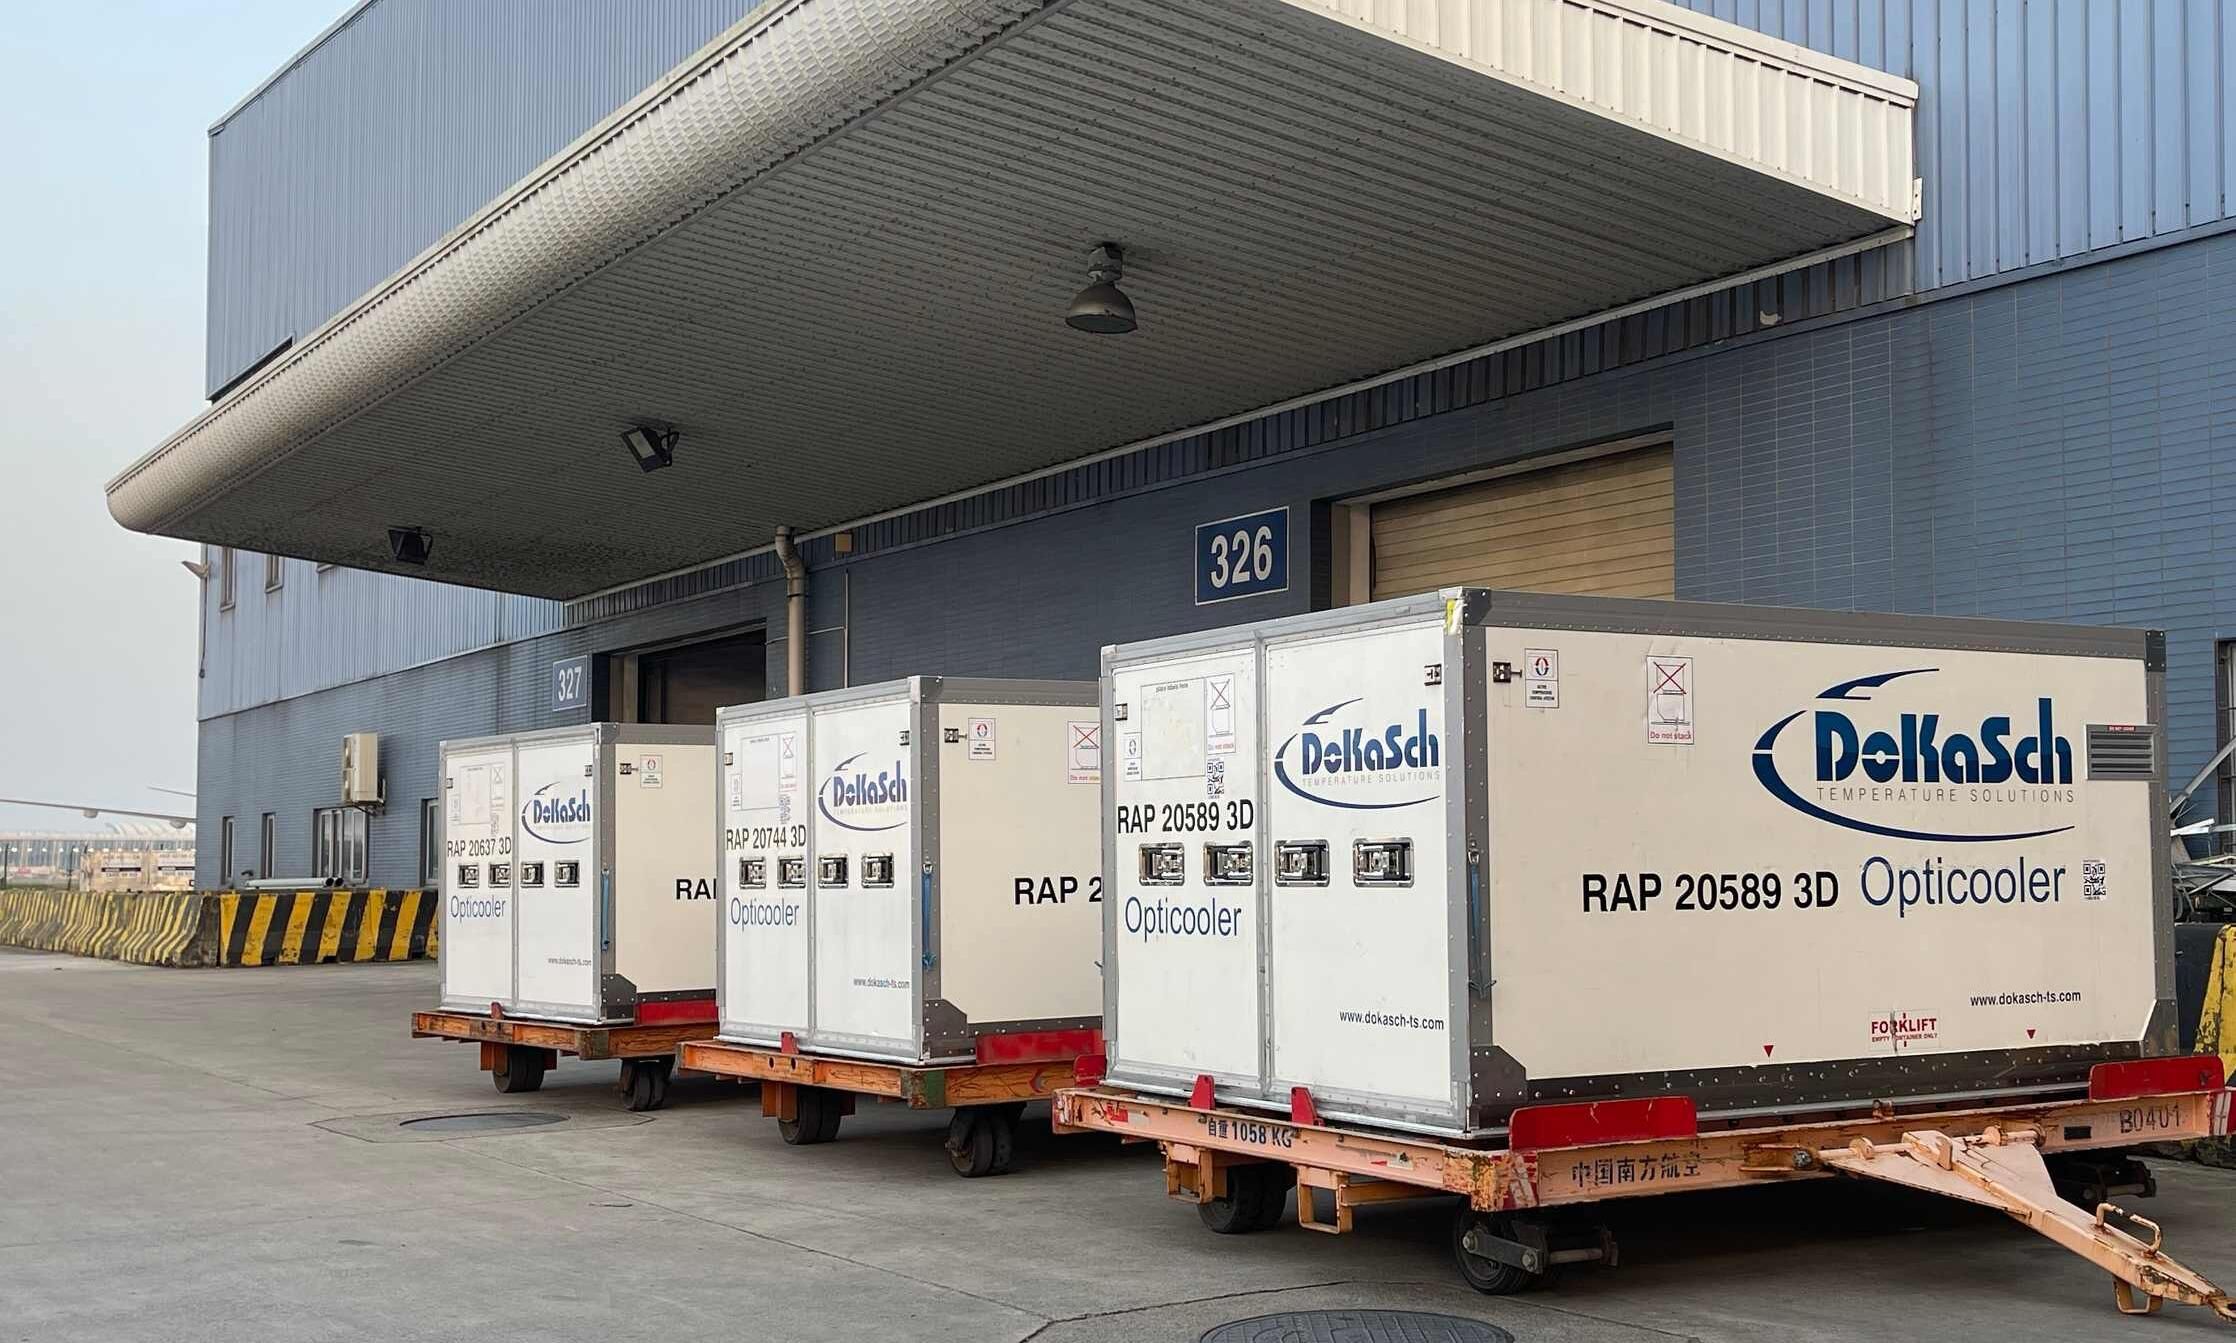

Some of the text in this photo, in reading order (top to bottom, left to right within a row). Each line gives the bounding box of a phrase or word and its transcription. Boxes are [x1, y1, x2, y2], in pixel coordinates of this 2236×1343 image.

[1210, 525, 1273, 589] 326
[558, 666, 582, 702] 327
[1302, 708, 1439, 775] DoKaSch
[1815, 697, 2073, 785] DoKaSch
[833, 760, 908, 808] DoKaSch
[1302, 769, 1441, 787] TEMPERATURE SOLUTIONS
[1817, 786, 2075, 804] TEMPERATURE SOLUTIONS
[533, 788, 591, 825] DoKaSch
[1117, 799, 1254, 834] RAP 20589 3D
[447, 836, 512, 858] RAP 20637 3D
[726, 824, 807, 850] RAP 20744 3D
[676, 878, 717, 900] RA
[1014, 877, 1079, 905] RAP
[1582, 871, 1839, 912] RAP 20589 3D
[1861, 856, 2067, 918] Opticooler
[450, 894, 506, 922] Opticooler
[730, 896, 800, 932] Opticooler
[1125, 896, 1242, 942] Opticooler
[1970, 989, 2082, 1007] www.dokasch-ts.com
[1339, 1010, 1445, 1031] www.dokasch-ts.com
[1208, 1118, 1293, 1149] 自重 1058 KG
